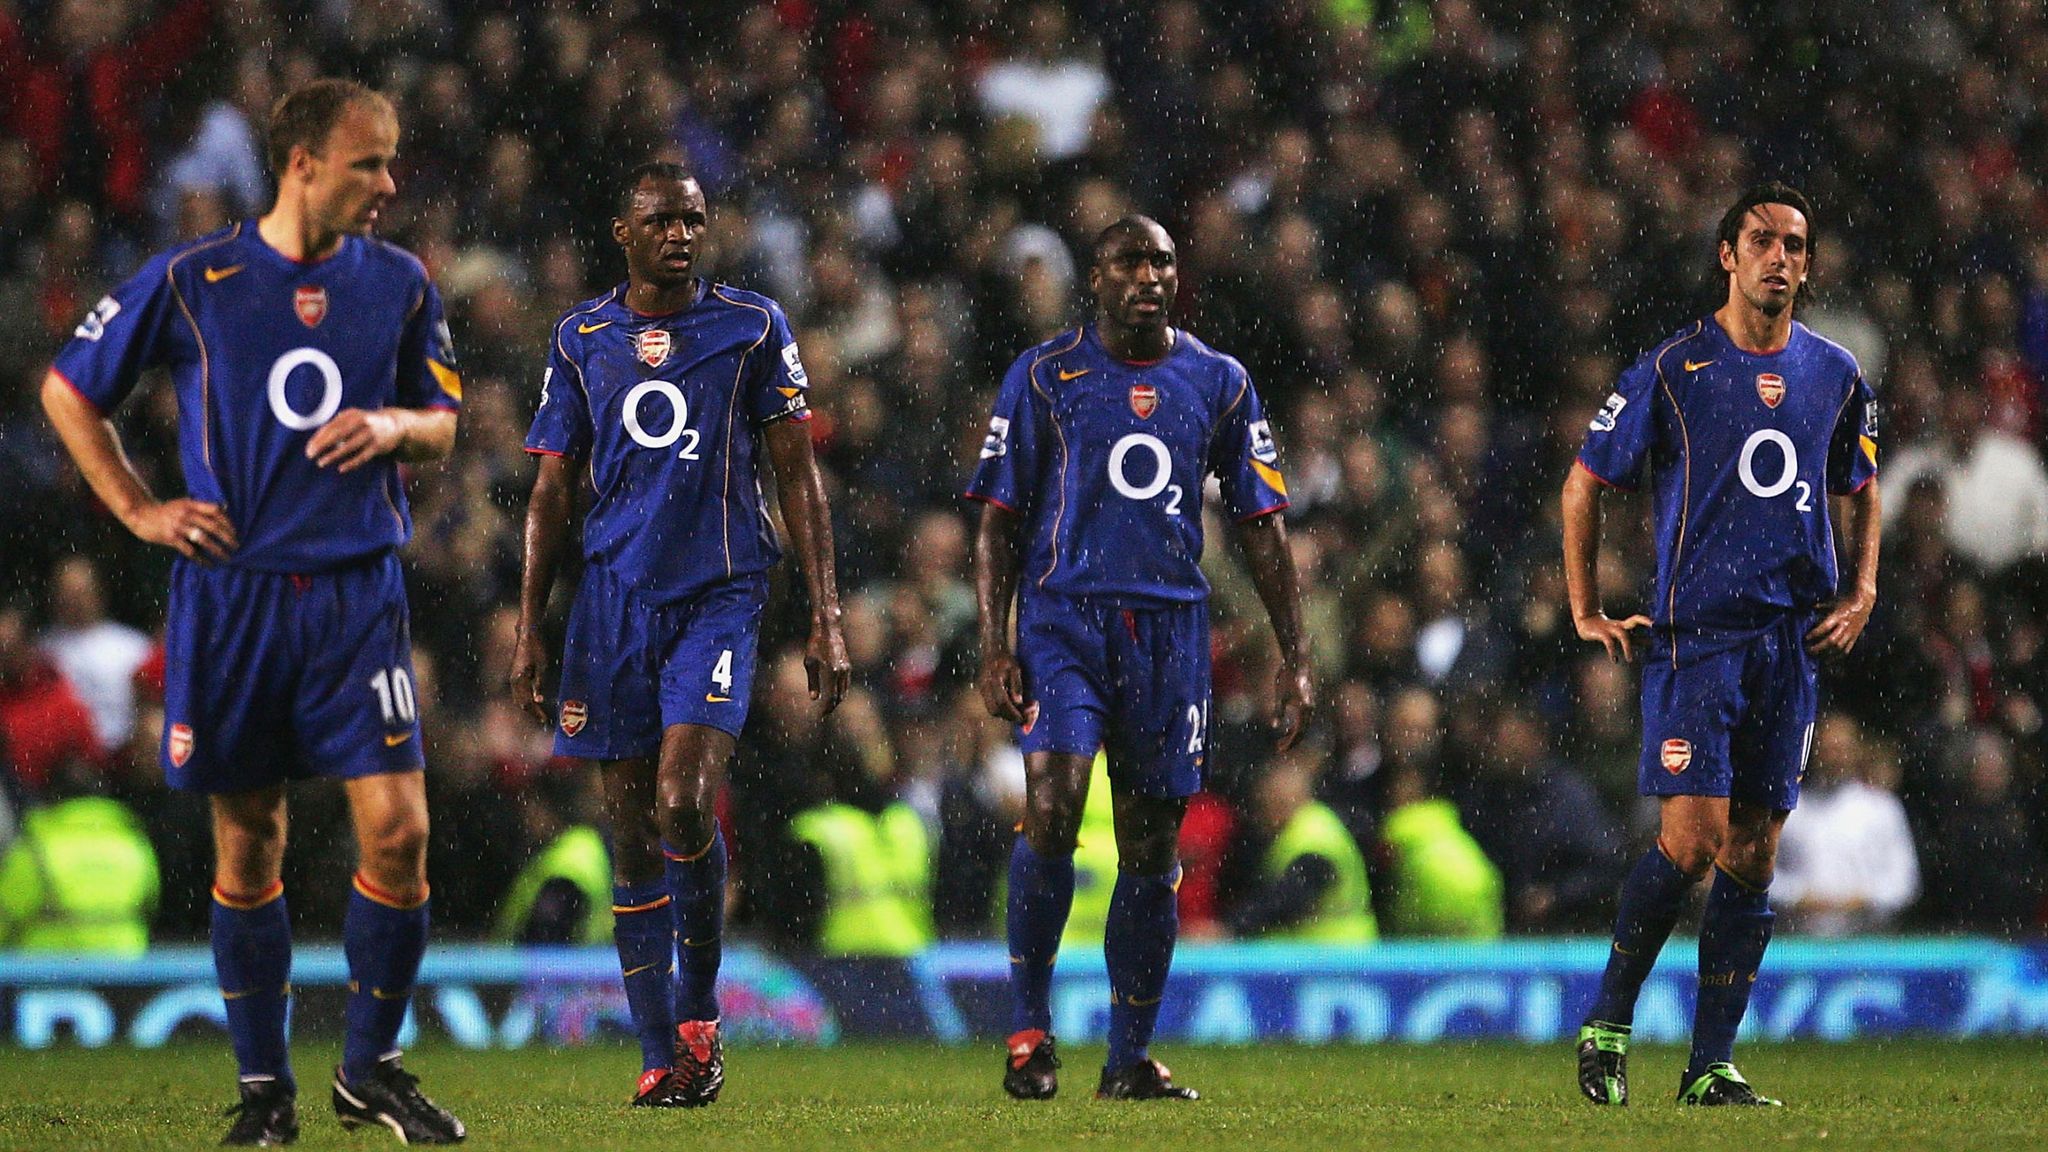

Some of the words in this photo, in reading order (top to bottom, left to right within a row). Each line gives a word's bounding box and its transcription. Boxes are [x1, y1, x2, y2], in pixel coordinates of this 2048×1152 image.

[267, 346, 343, 431] O
[622, 379, 701, 461] O2
[1108, 432, 1183, 515] O2
[1738, 428, 1812, 512] O2
[370, 667, 416, 724] 10
[711, 649, 733, 695] 4
